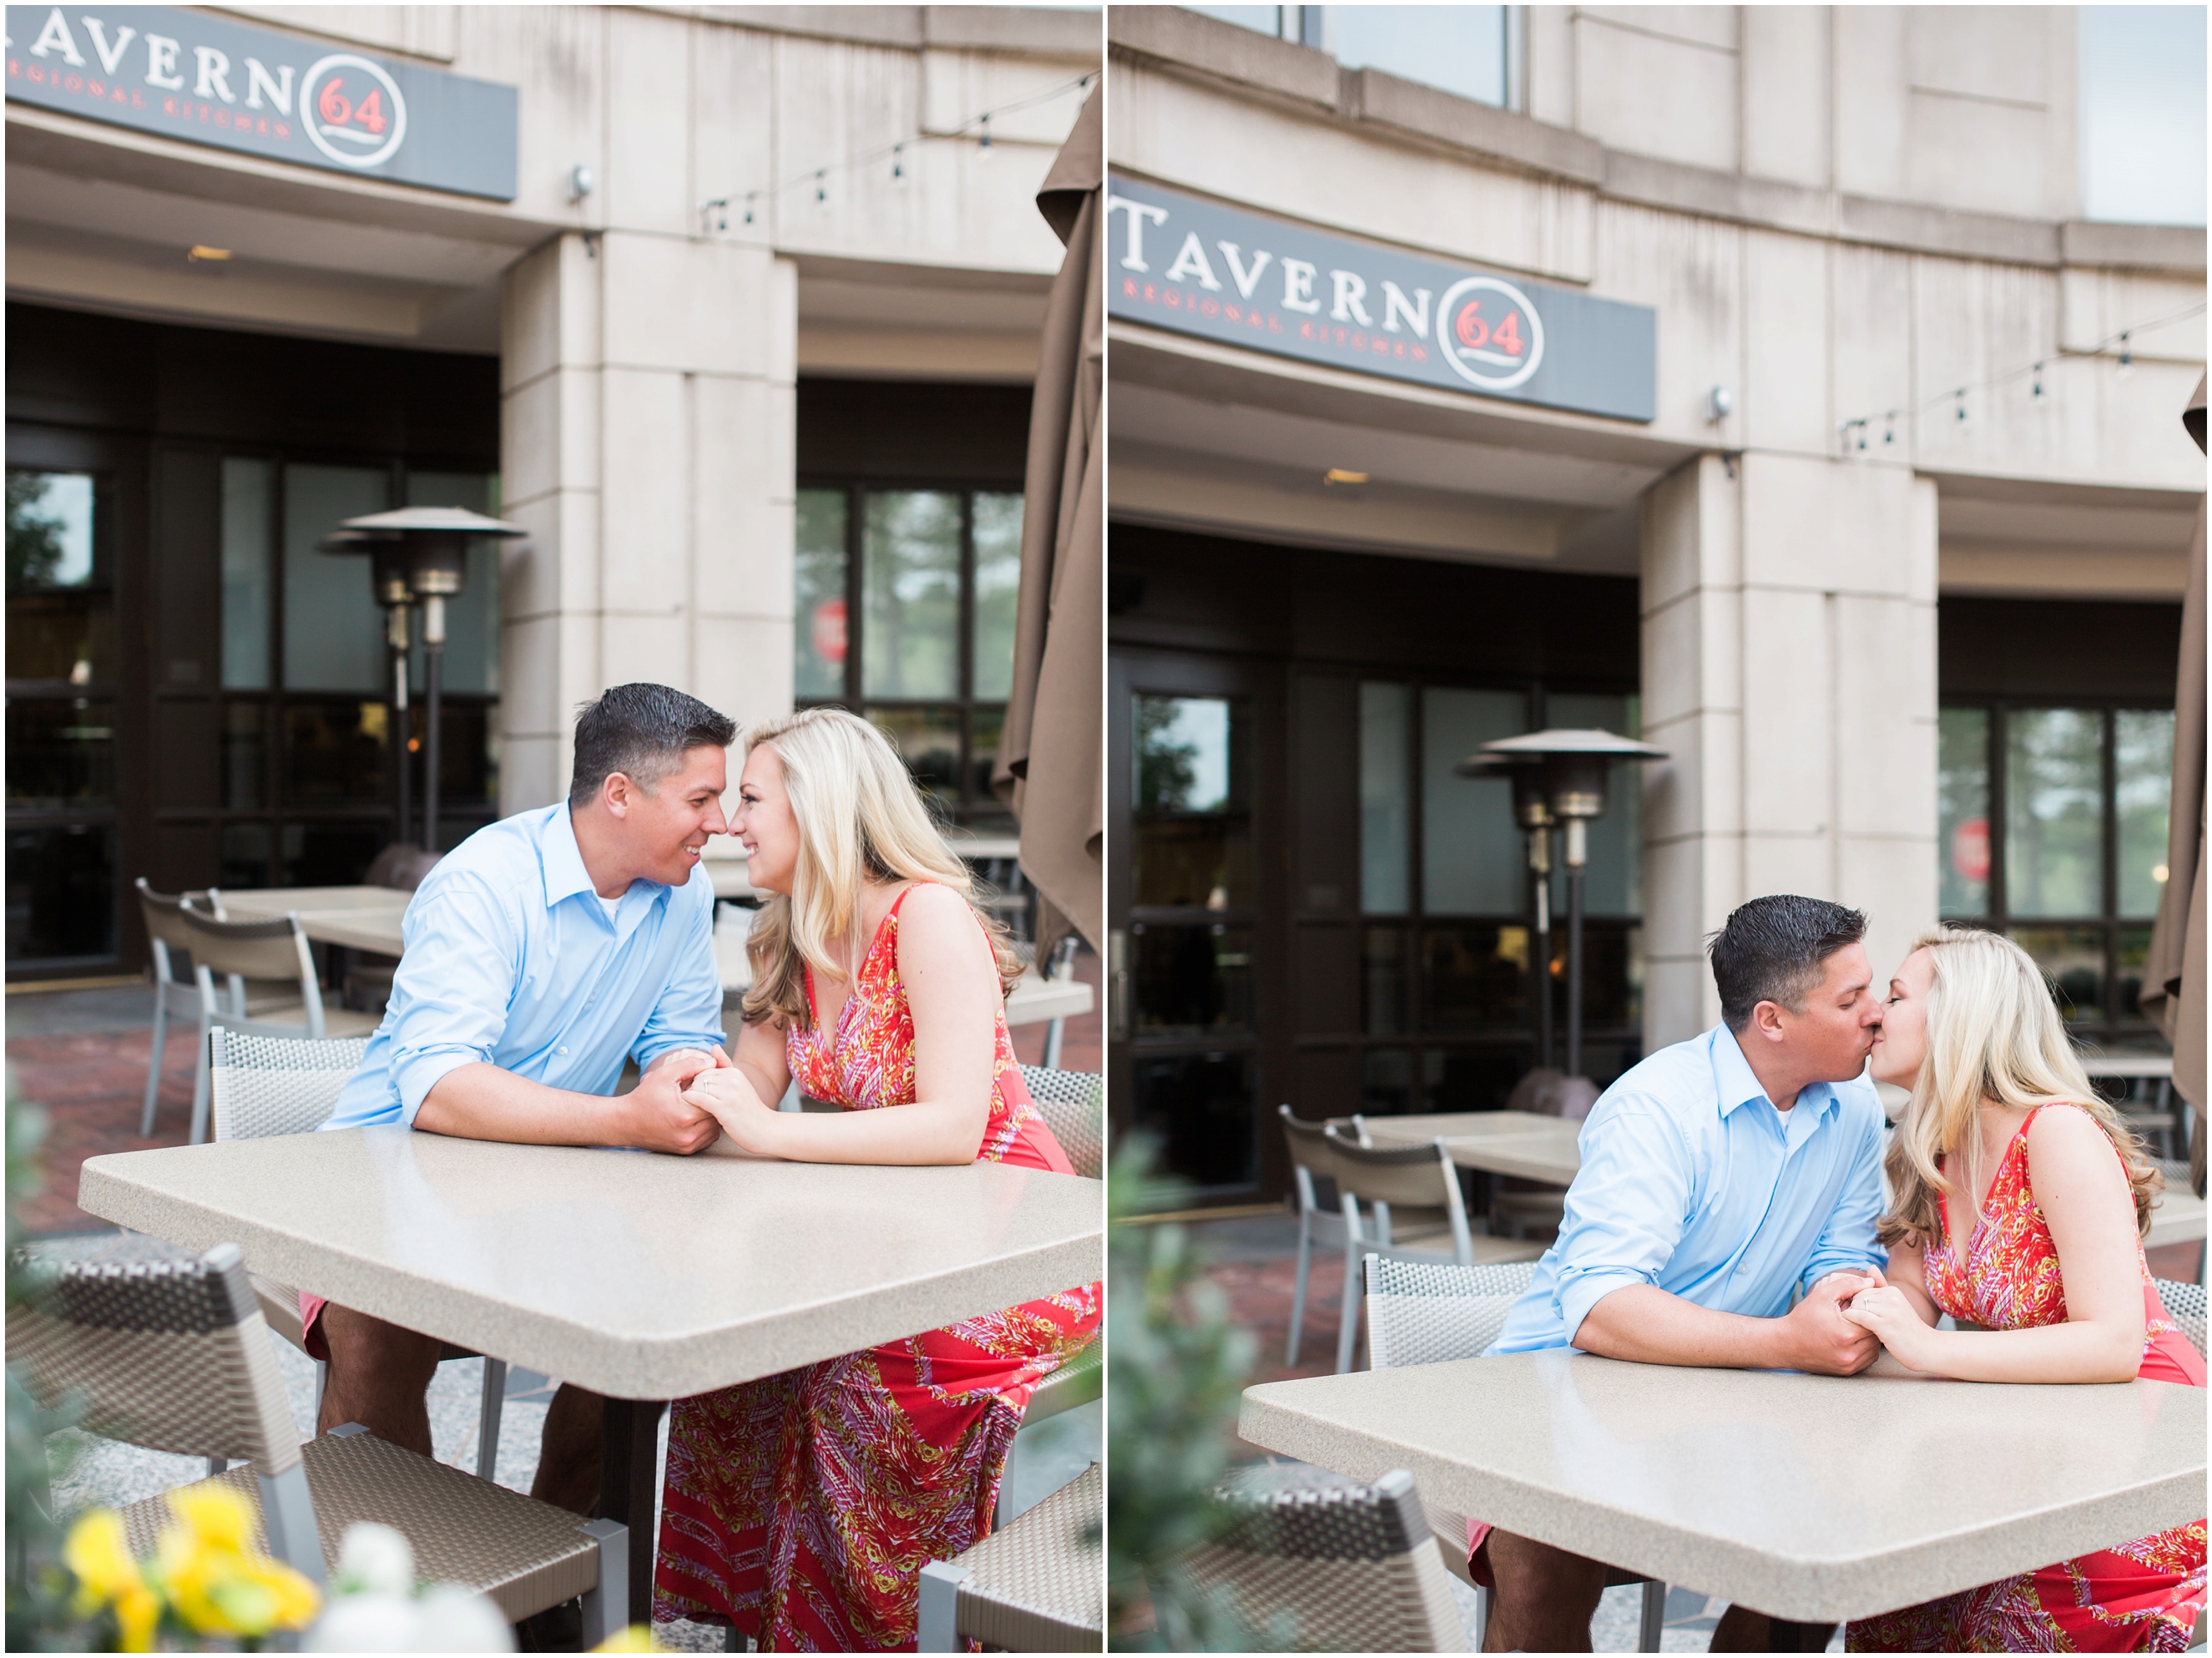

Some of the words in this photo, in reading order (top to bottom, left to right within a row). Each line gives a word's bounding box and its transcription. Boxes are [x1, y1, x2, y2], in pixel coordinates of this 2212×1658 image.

[5, 6, 296, 117] AVERN
[318, 78, 386, 134] 64
[163, 96, 291, 141] KITCHEN
[1108, 194, 1432, 340] TAVERN
[1456, 301, 1525, 355] 64
[1122, 276, 1284, 334] REGIONAL
[1299, 320, 1428, 364] KITCHEN
